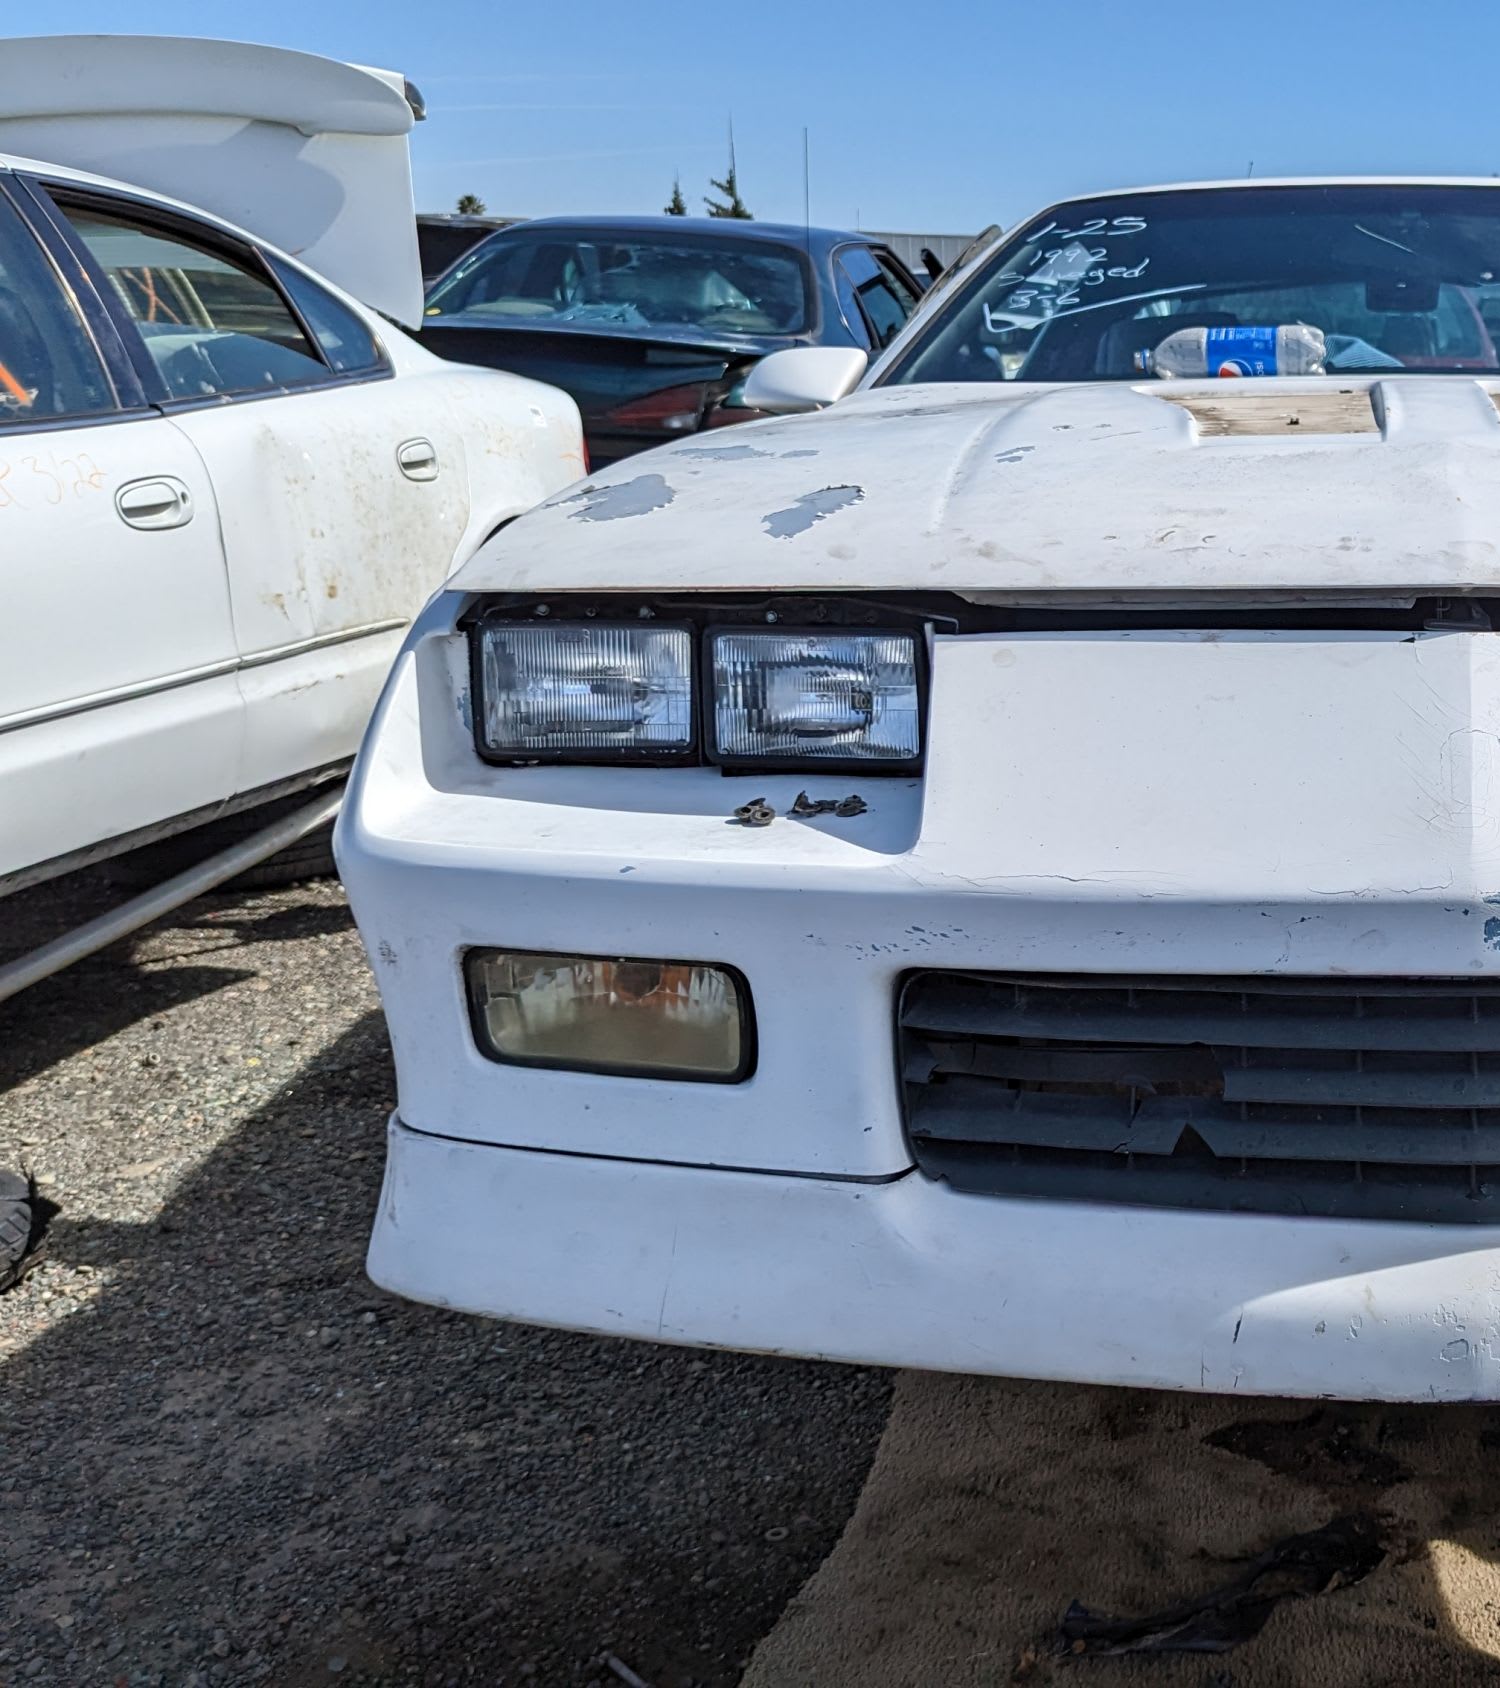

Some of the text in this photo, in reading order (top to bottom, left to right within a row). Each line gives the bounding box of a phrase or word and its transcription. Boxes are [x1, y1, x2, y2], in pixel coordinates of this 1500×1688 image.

[1026, 216, 1148, 242] 1-25
[1029, 247, 1109, 267] 1992
[998, 257, 1150, 287] Slvaged
